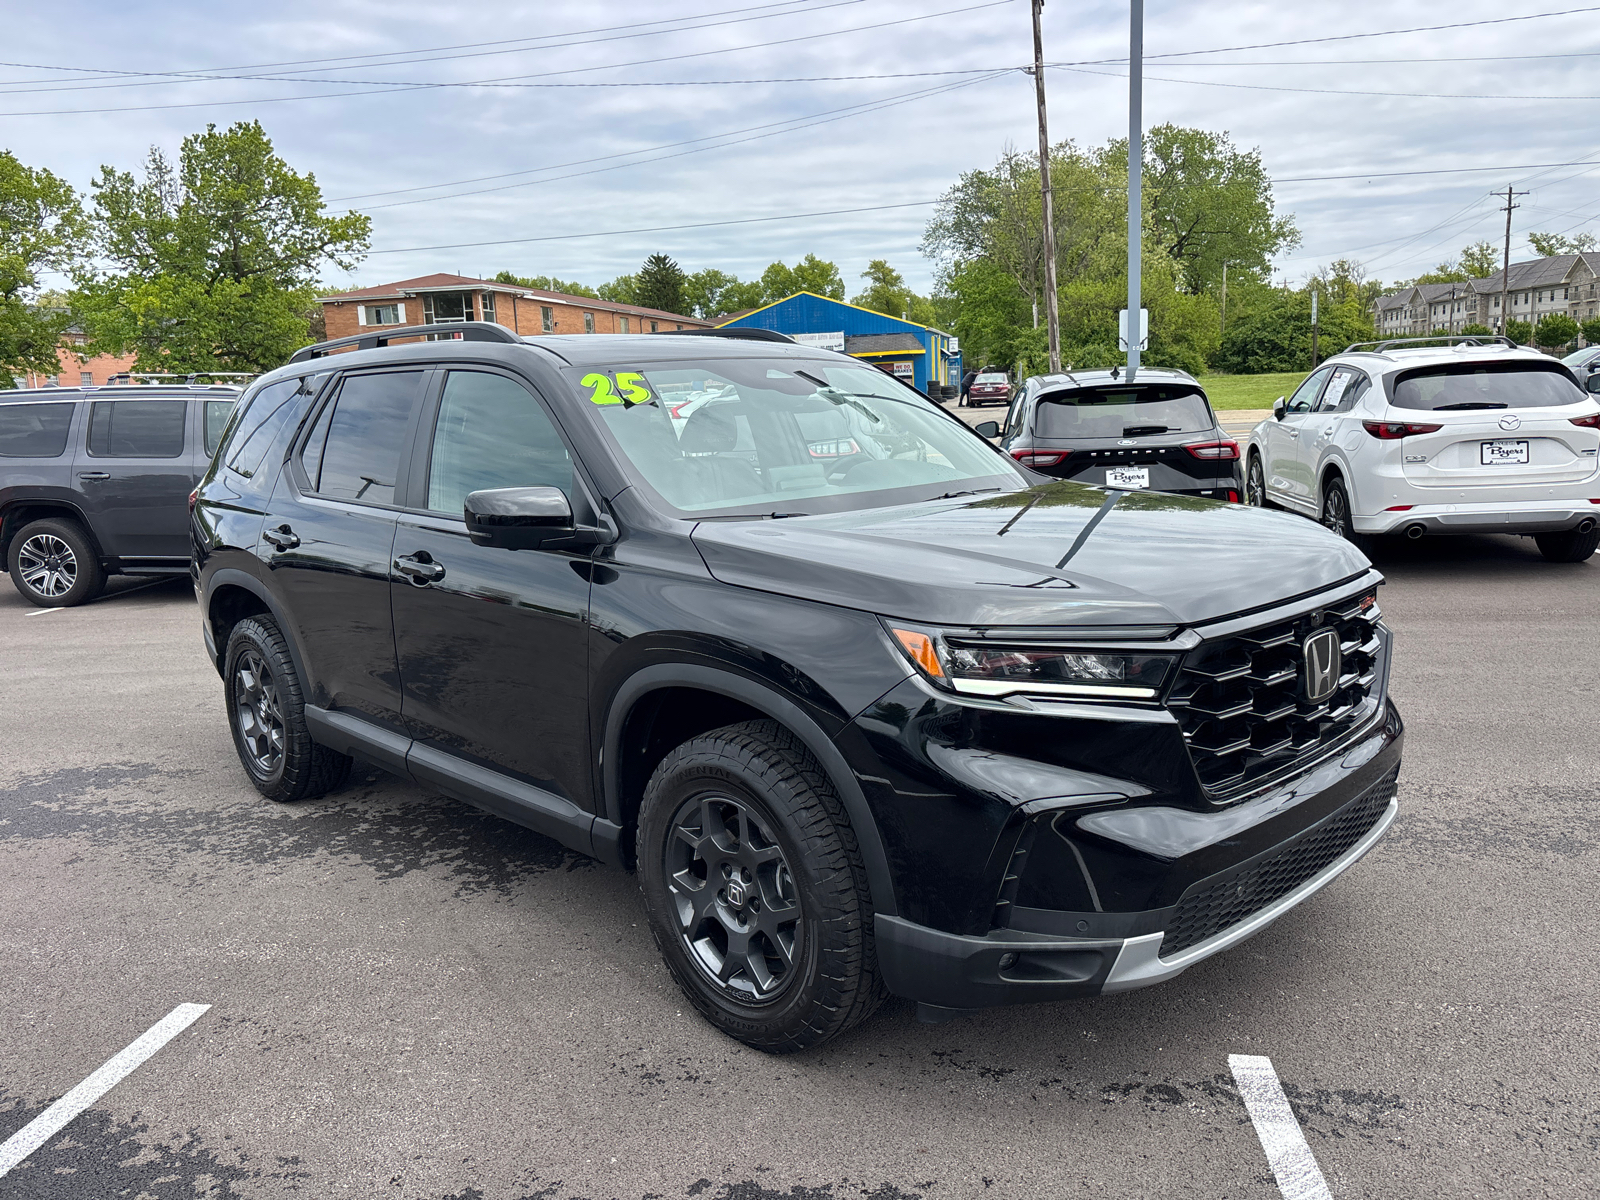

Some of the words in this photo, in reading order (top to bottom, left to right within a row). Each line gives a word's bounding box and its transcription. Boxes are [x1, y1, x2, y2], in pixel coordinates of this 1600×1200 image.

[580, 372, 651, 405] 25
[1486, 446, 1523, 457] Byers
[1109, 472, 1145, 483] Byers
